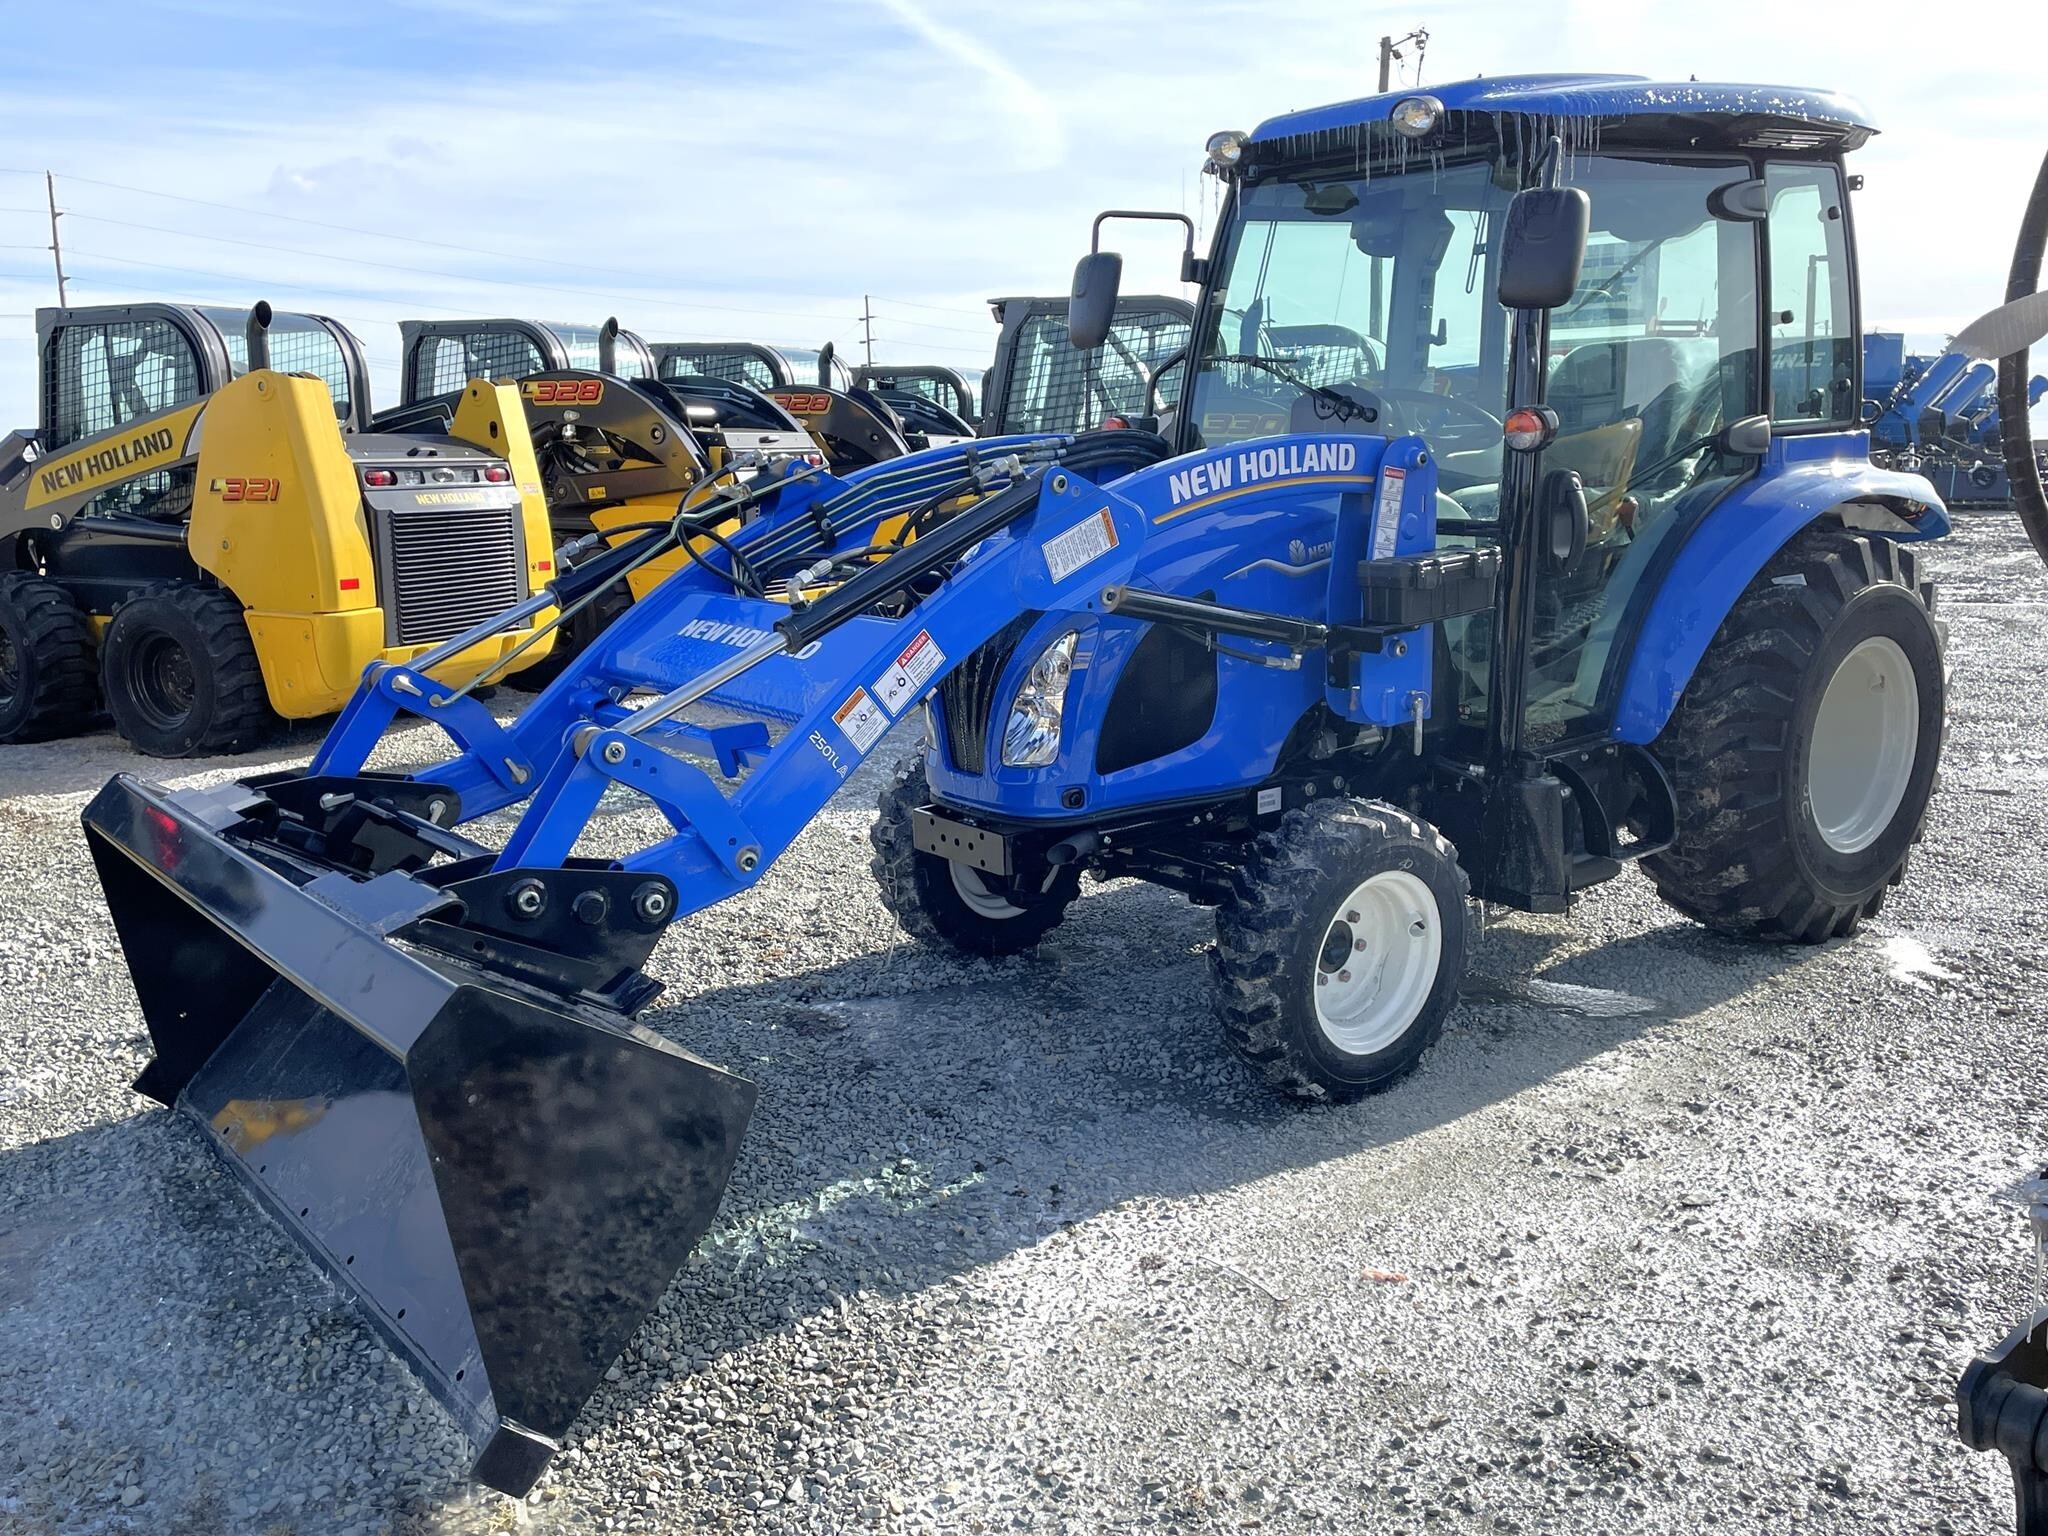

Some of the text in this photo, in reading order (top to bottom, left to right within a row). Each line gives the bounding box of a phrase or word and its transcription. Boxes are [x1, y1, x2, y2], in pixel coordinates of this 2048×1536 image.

[522, 380, 602, 403] L328
[41, 427, 174, 495] NEW HOLLAND
[1169, 443, 1356, 505] NEW HOLLAND
[209, 478, 281, 502] L321
[415, 493, 441, 505] NEW
[677, 619, 733, 642] NEW
[905, 634, 928, 659] DANGER
